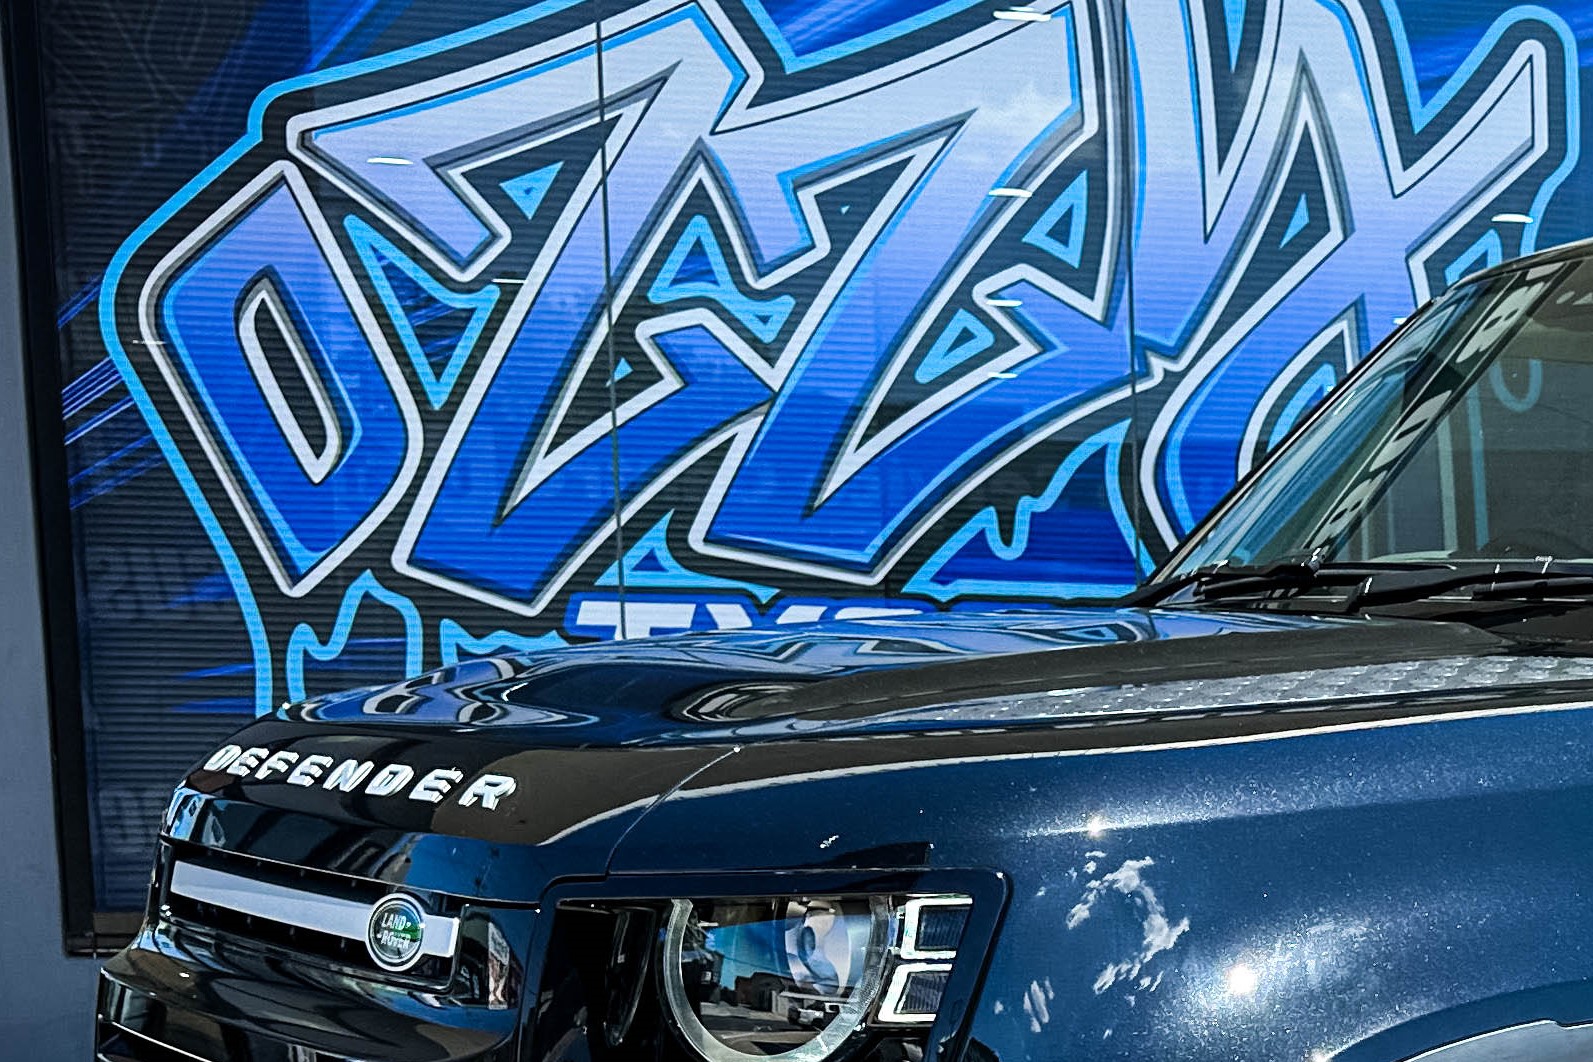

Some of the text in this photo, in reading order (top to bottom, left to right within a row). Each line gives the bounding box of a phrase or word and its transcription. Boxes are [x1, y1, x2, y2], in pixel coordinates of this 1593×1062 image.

[203, 744, 517, 811] DEFENDER
[381, 912, 407, 931] LAND
[381, 929, 411, 949] ROVER
